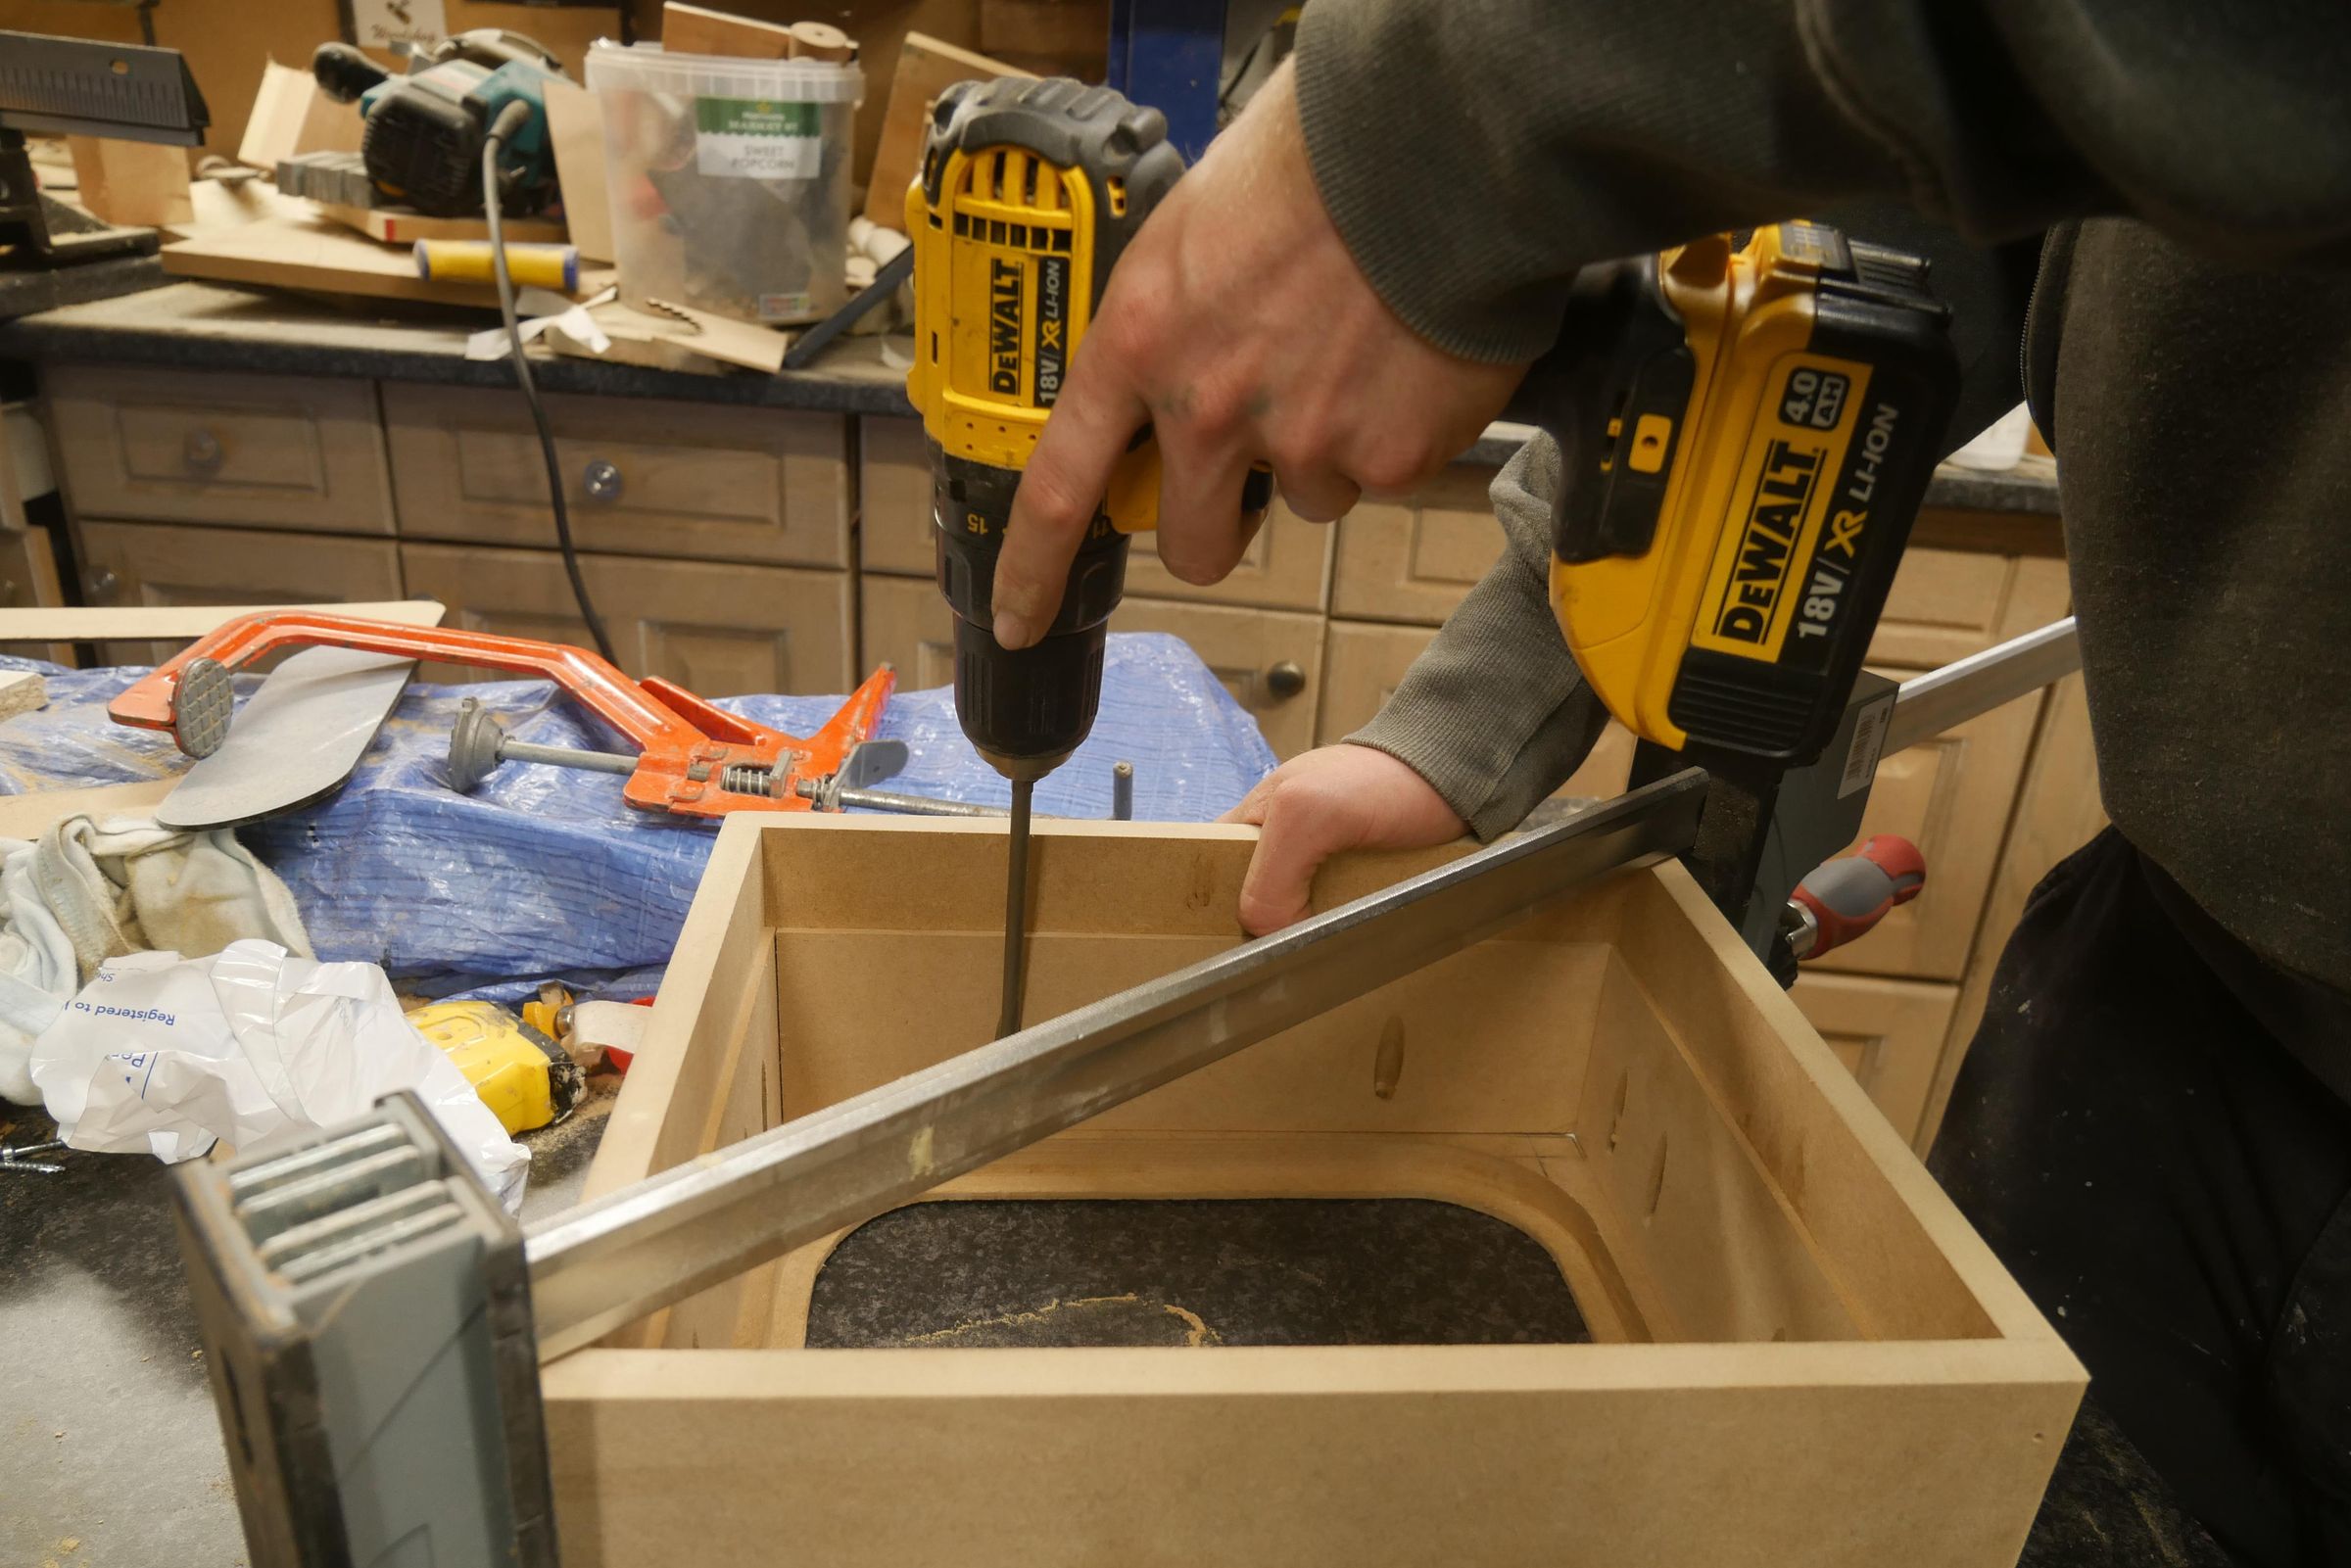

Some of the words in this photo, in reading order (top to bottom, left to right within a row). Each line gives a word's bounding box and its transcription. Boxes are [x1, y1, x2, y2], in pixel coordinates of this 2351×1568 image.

[744, 145, 784, 156] SWEET
[731, 159, 795, 170] POPCORN
[1045, 261, 1061, 319] LI-ION
[1785, 371, 1818, 423] 4.0
[1848, 404, 1898, 503] LI-ION
[967, 513, 988, 535] 15
[74, 1001, 91, 1012] to
[94, 1004, 175, 1025] Registered
